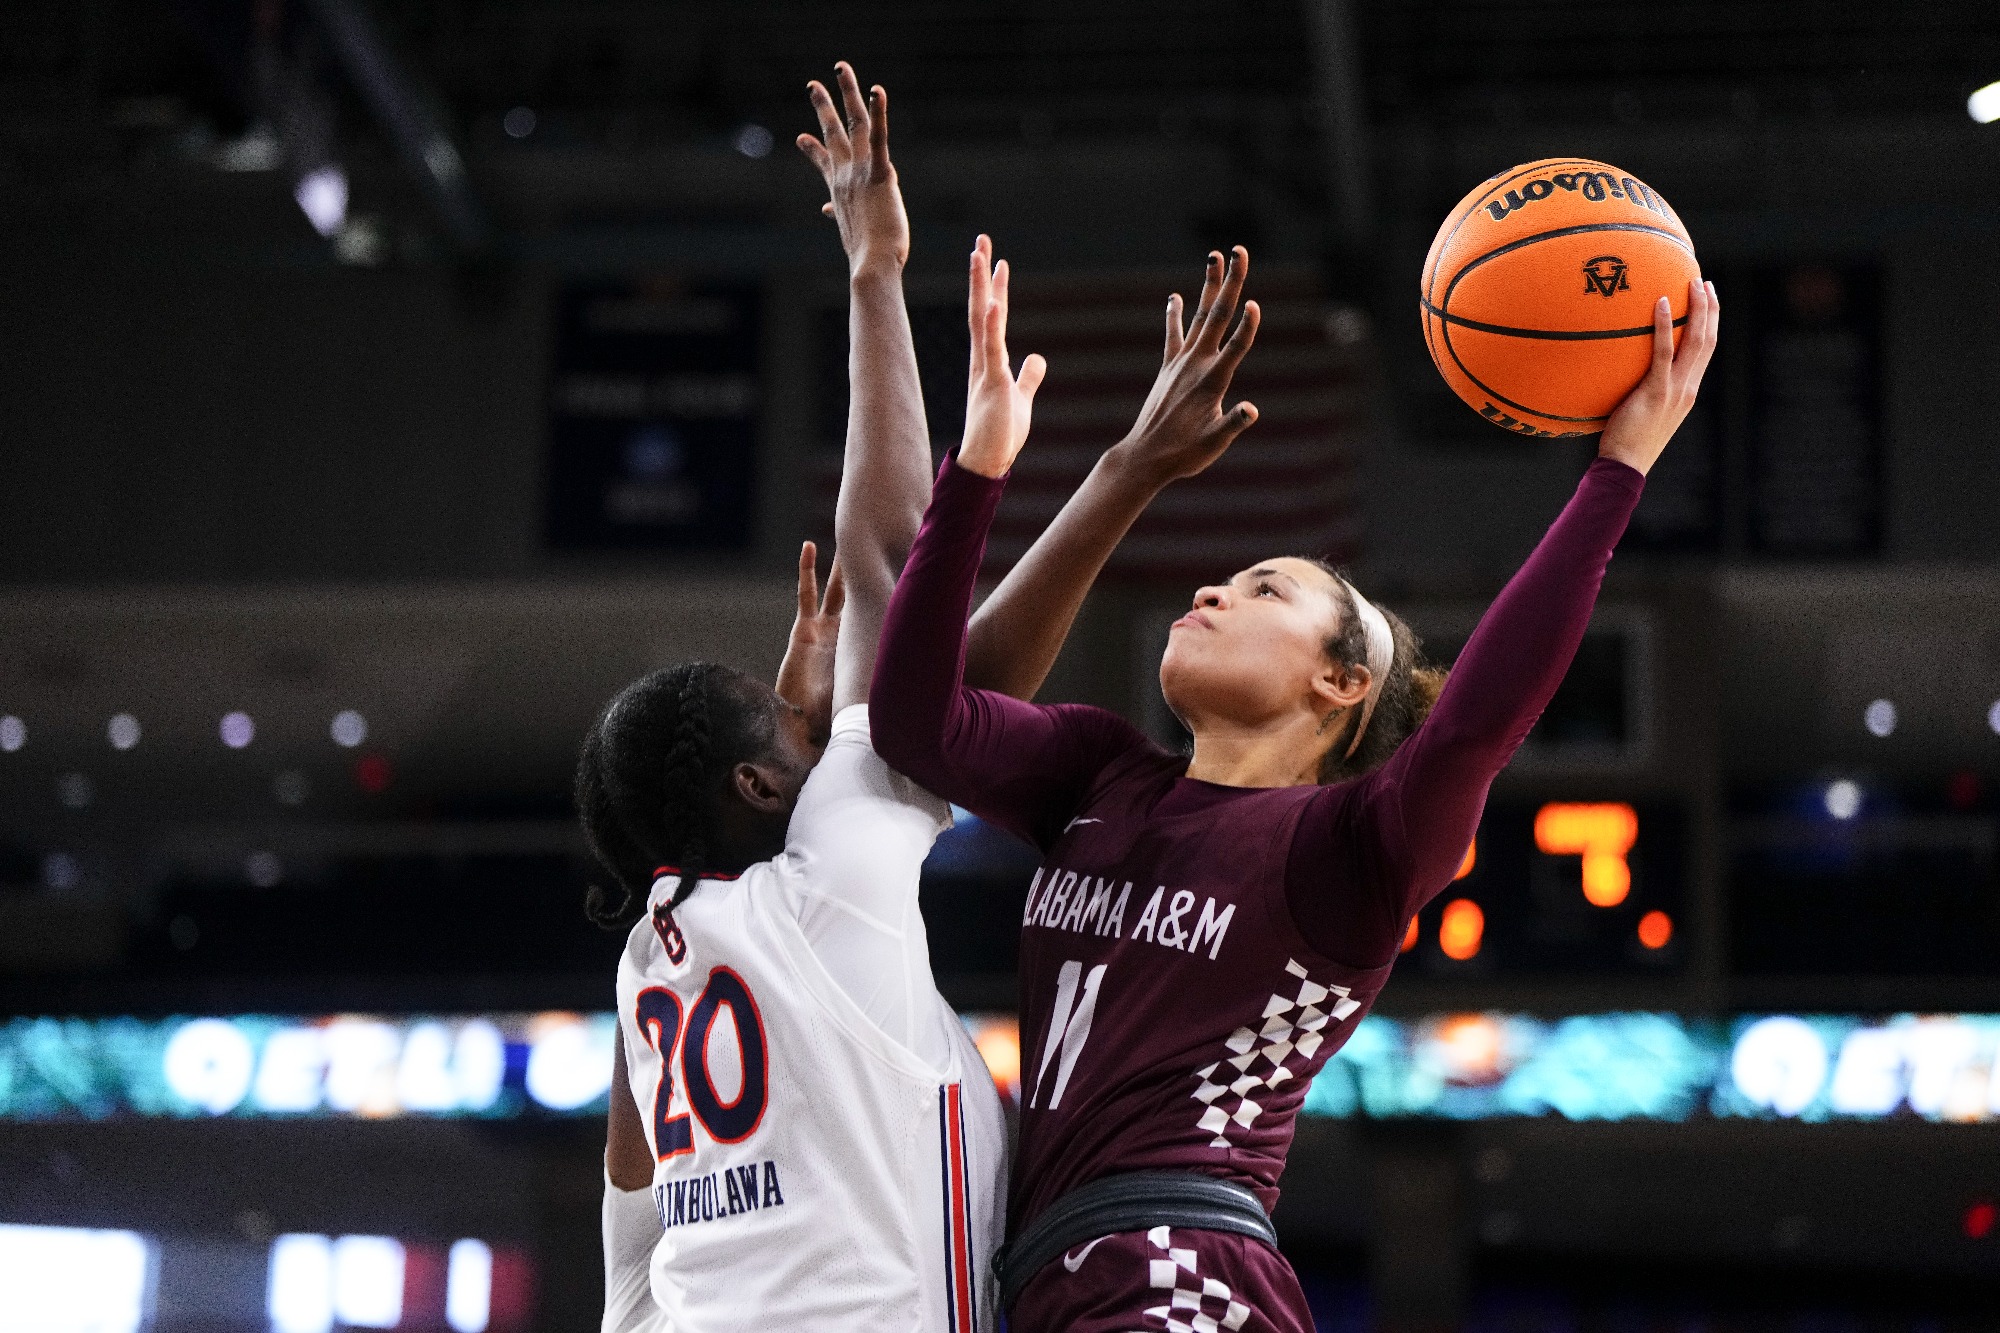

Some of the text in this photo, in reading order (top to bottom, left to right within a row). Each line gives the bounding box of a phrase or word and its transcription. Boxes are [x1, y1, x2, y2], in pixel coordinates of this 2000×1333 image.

[1484, 171, 1674, 222] Wilson
[1023, 867, 1236, 960] LABAMA A&M
[636, 965, 768, 1163] 20
[1030, 960, 1108, 1110] 11
